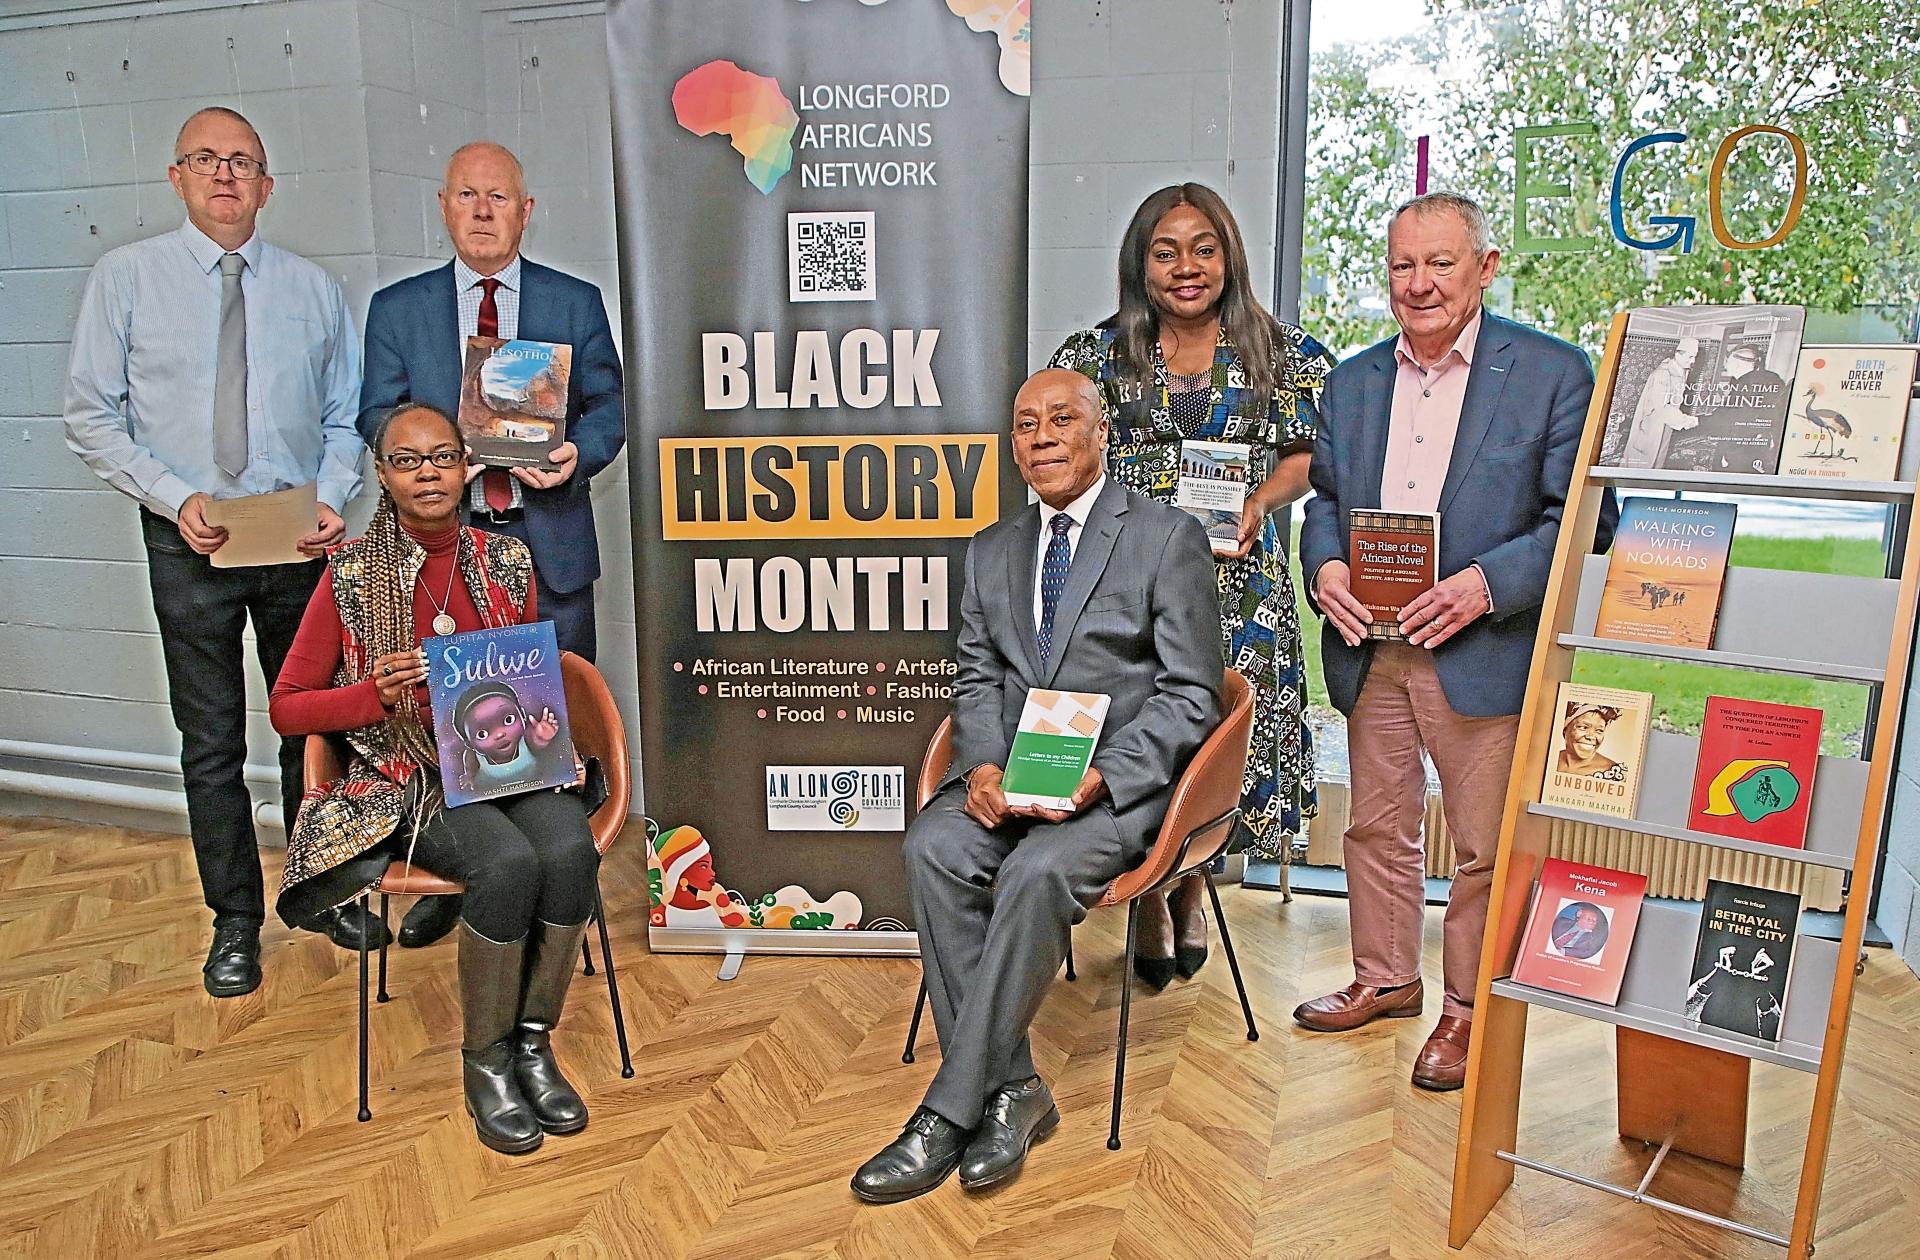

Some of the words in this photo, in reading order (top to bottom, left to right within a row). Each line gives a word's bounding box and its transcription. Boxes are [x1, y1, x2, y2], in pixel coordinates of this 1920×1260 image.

[799, 84, 950, 110] LONGFORD
[799, 123, 932, 149] AFRICANS
[800, 162, 937, 188] NETWORK
[491, 346, 549, 361] LESOTHO
[701, 328, 942, 410] BLACK
[1856, 360, 1885, 369] BIRTH
[1848, 370, 1884, 380] DREAM
[1676, 383, 1705, 392] ONCE
[1708, 383, 1739, 392] UPON
[1741, 384, 1749, 393] A
[1752, 384, 1779, 393] TIME
[1841, 380, 1882, 391] WEAVER
[675, 443, 987, 523] HISTORY
[1670, 508, 1710, 516] MORRISON
[1633, 519, 1716, 538] WALKING
[1357, 540, 1376, 551] The
[1378, 541, 1398, 552] Rise
[1400, 543, 1410, 552] of
[1411, 543, 1427, 553] the
[1650, 536, 1692, 551] WITH
[1360, 553, 1394, 564] African
[1397, 555, 1424, 565] Novel
[1626, 552, 1709, 570] NOMADS
[694, 556, 948, 633] MONTH
[443, 633, 485, 645] LUPITA
[443, 641, 546, 689] Sulwe
[692, 659, 765, 675] African
[770, 659, 869, 675] Literature
[717, 682, 861, 698] Entertainment
[886, 682, 958, 699] Fashio
[776, 706, 825, 722] Food
[856, 706, 915, 722] Music
[1725, 716, 1763, 725] CONQUERED
[1733, 710, 1765, 719] QUESTION
[1775, 715, 1809, 725] LESOTHO'S
[1775, 731, 1801, 739] ANSWER
[1029, 751, 1046, 759] Letters
[483, 786, 508, 796] VASHTI
[509, 780, 545, 791] HARRISON
[769, 774, 788, 797] AN
[1554, 774, 1625, 797] UNBOWED
[1549, 794, 1585, 807] WANGARI
[1589, 801, 1625, 814] MAATHAI
[1575, 882, 1606, 897] Kena
[1598, 879, 1618, 888] Jacob
[1715, 909, 1781, 930] BETRAYAL
[1709, 919, 1723, 931] IN
[1727, 923, 1753, 936] THE
[1756, 929, 1787, 943] CITY
